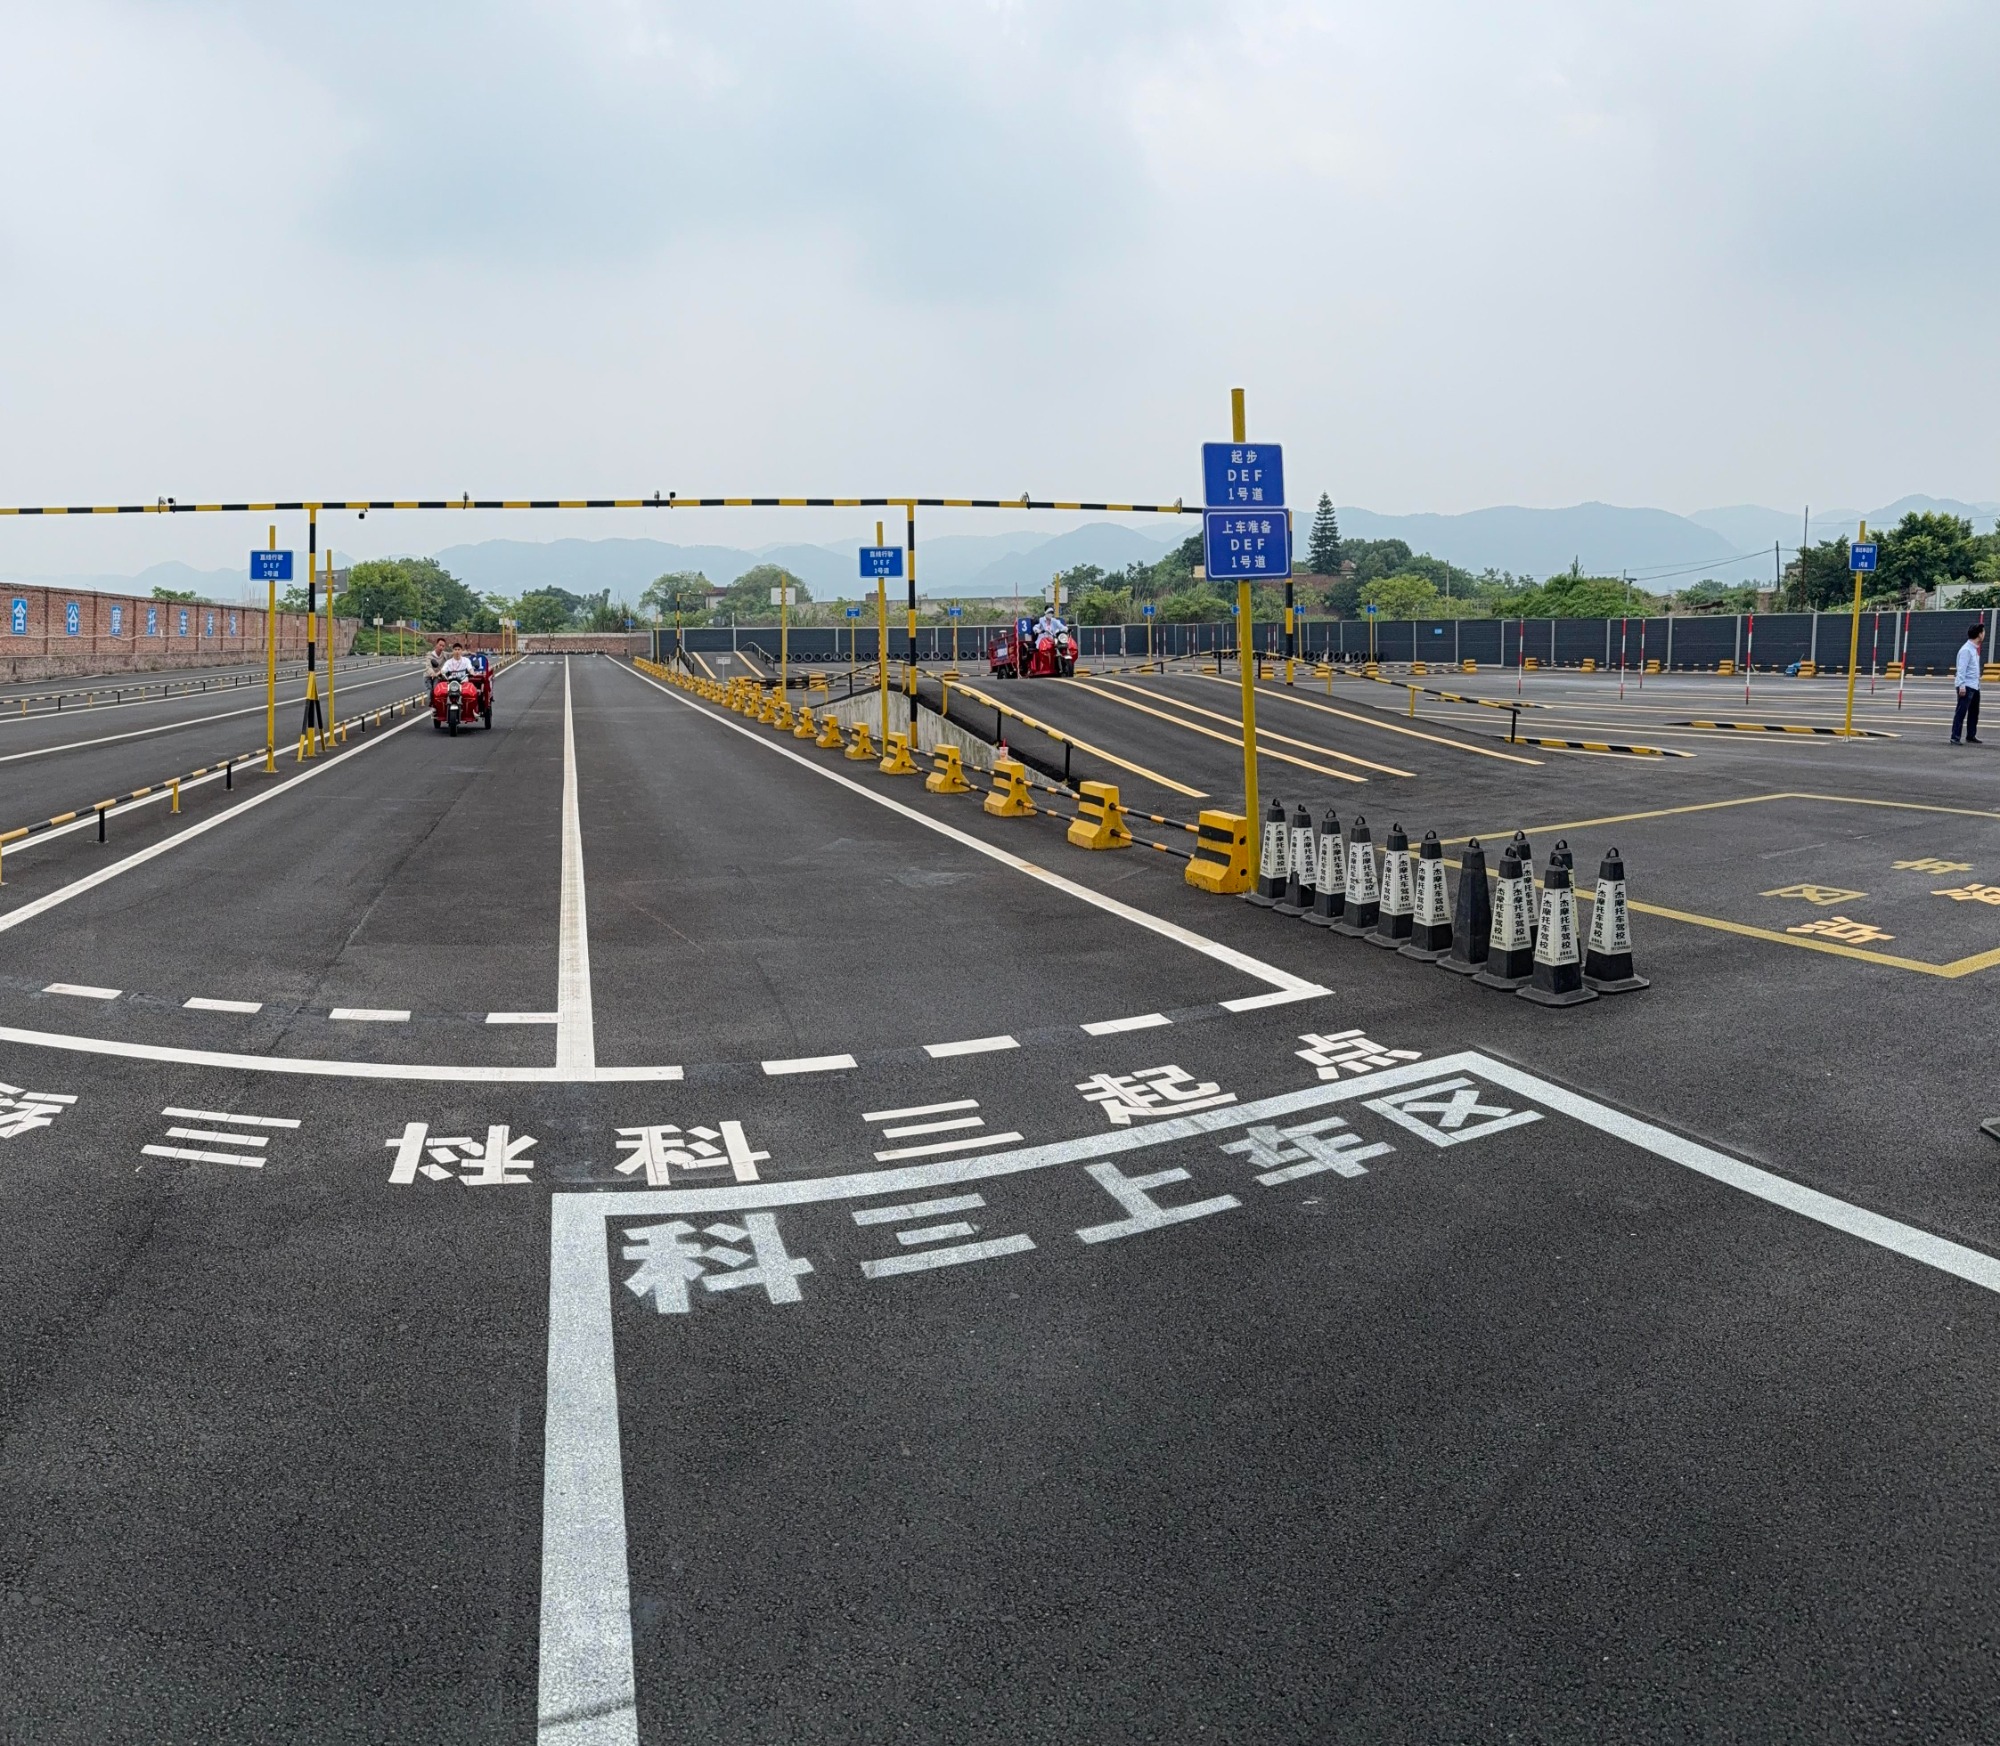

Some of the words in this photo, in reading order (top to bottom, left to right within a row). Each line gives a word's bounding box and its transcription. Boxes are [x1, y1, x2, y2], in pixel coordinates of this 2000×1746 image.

[1230, 450, 1258, 464] 起步
[1228, 487, 1264, 501] 1号道
[1222, 520, 1272, 534] 上车准备
[1231, 555, 1266, 569] 1号道
[1021, 620, 1028, 631] 3
[1303, 829, 1314, 872] 广杰摩托车驾校
[1332, 836, 1344, 881] 广杰摩托车驾校
[1399, 852, 1410, 902] 广杰摩托车驾校
[1432, 860, 1444, 912] 广杰摩托车驾校
[1494, 880, 1506, 935] 广杰摩托车驾校
[1512, 880, 1525, 936] 广杰摩托车驾校
[1539, 891, 1553, 949] 广杰摩托车驾校
[1559, 891, 1571, 949] 广杰摩托车驾校
[1593, 882, 1607, 938] 广杰摩托车驾校
[1614, 882, 1626, 939] 广杰摩托车驾校
